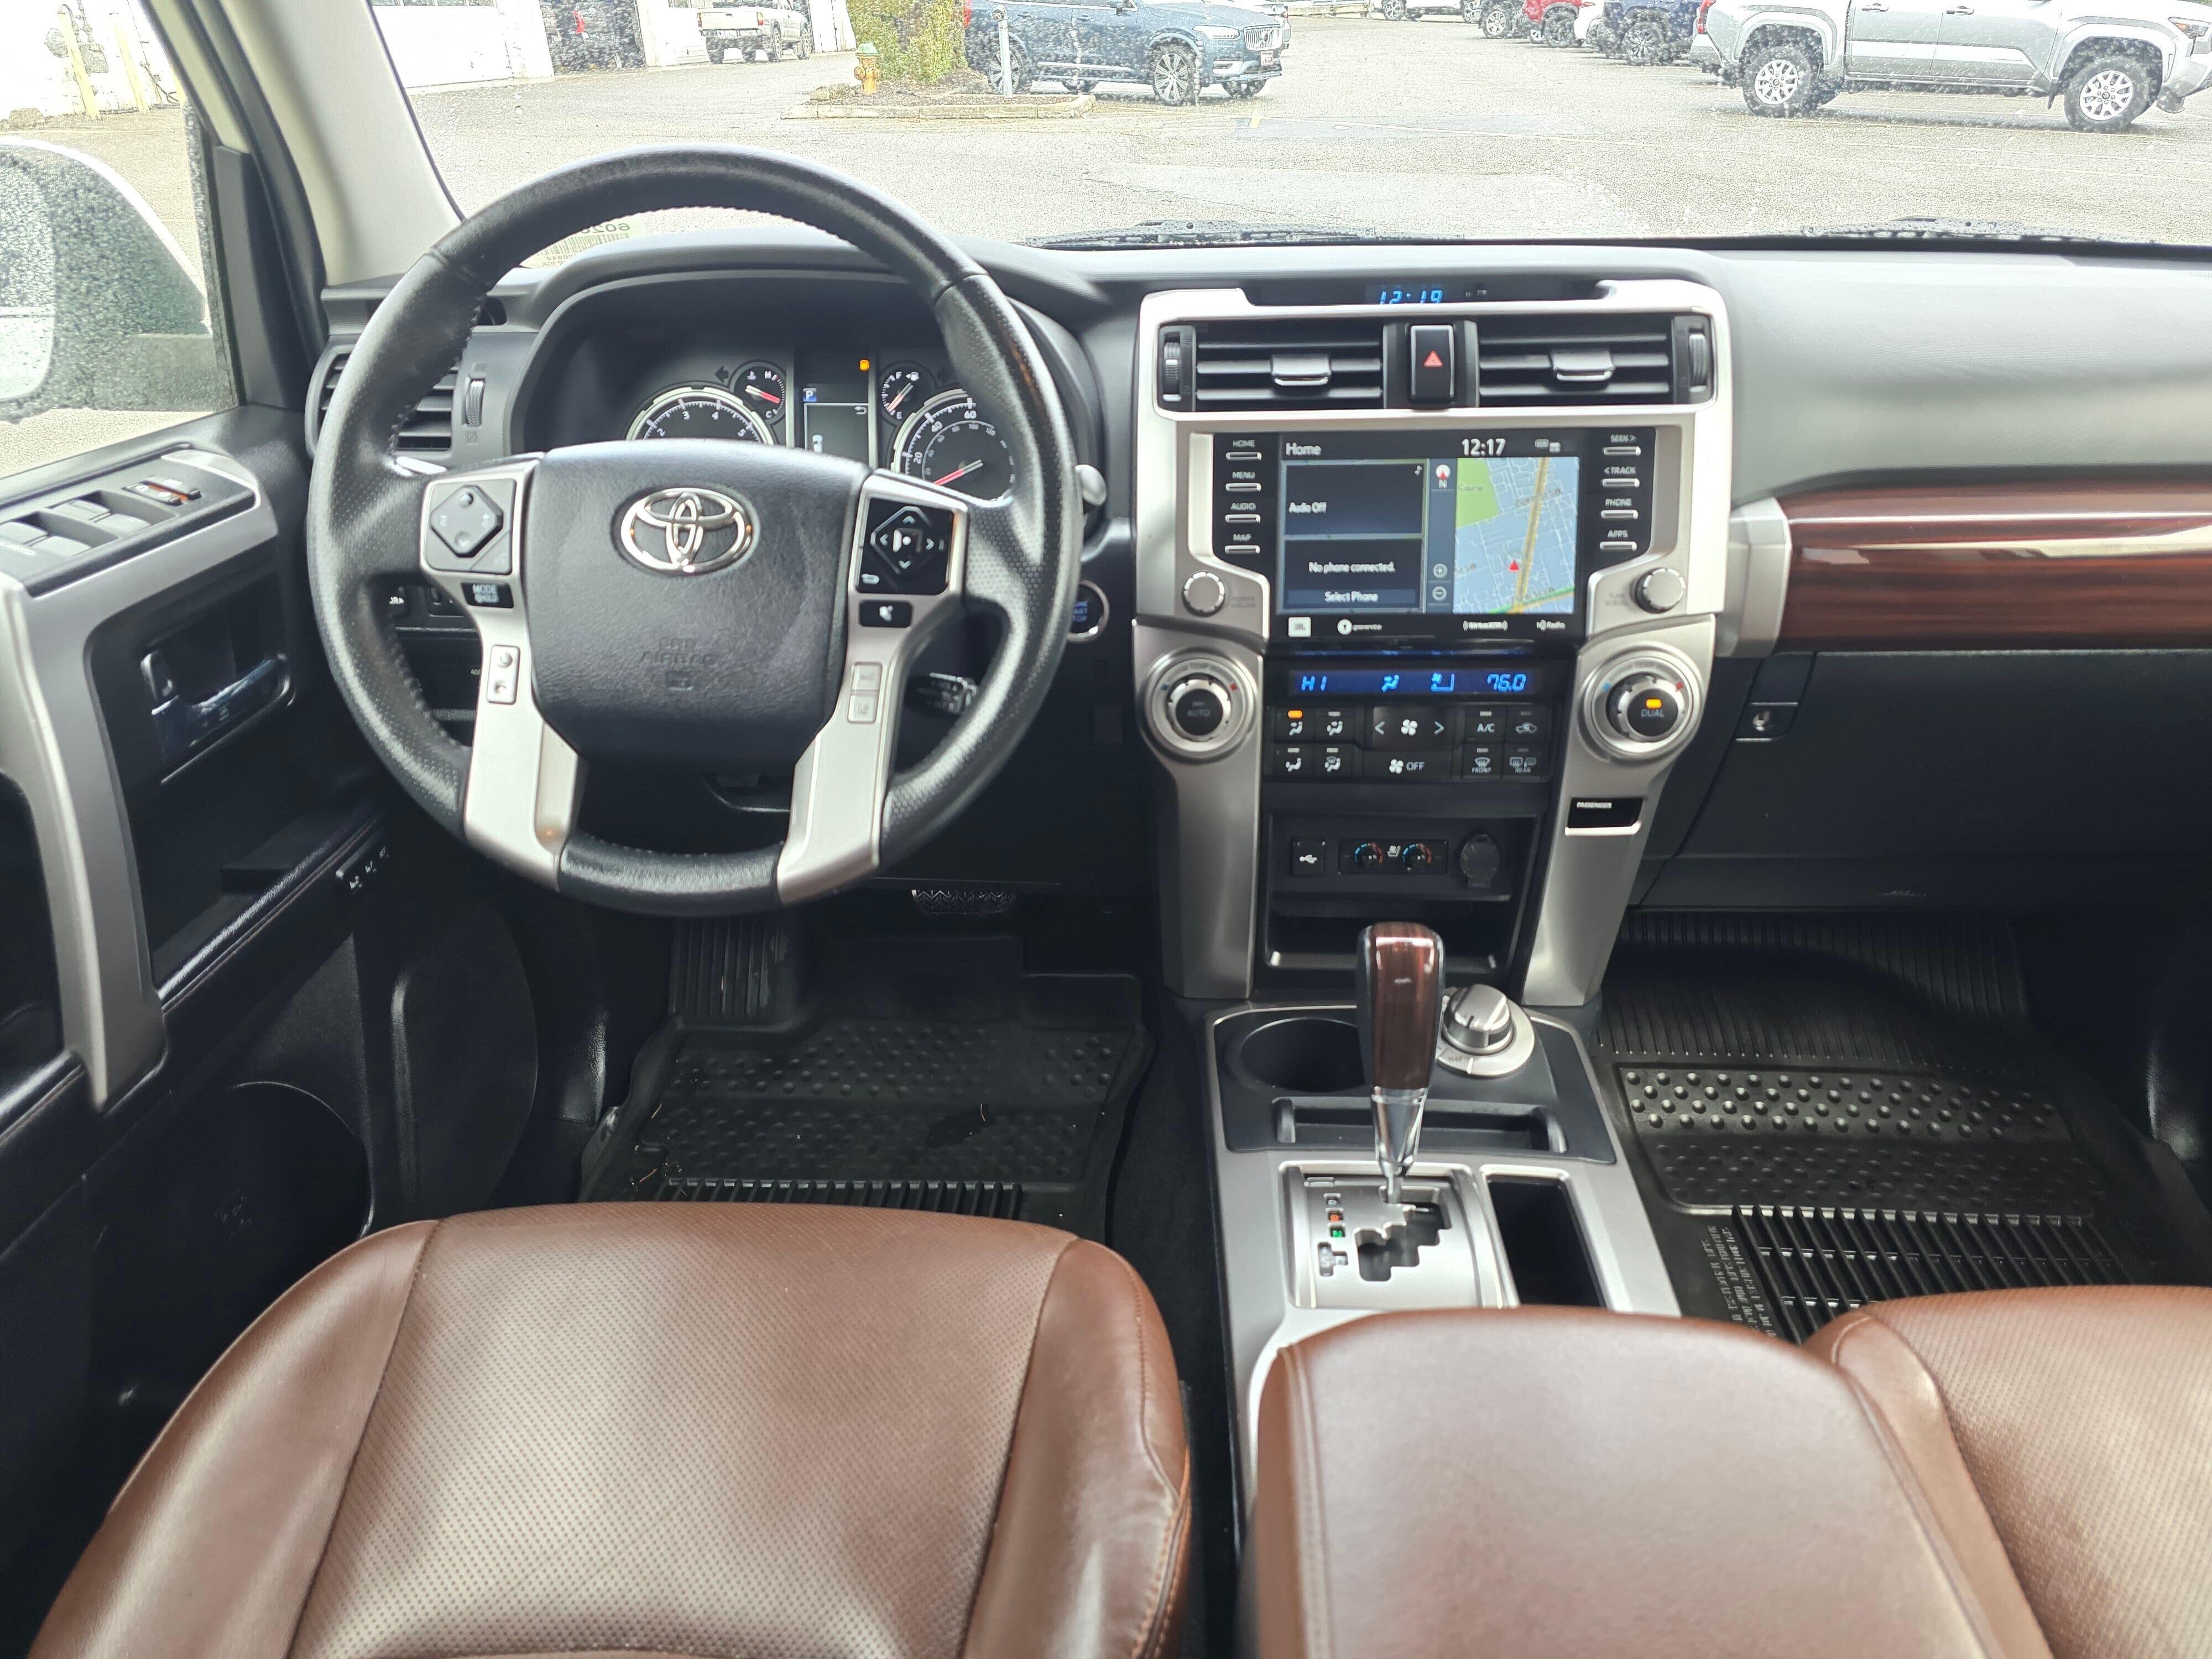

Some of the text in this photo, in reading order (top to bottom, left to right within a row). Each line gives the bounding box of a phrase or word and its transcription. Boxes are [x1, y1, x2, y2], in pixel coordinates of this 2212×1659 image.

[896, 371, 902, 379] F
[682, 411, 690, 420] 3
[711, 411, 719, 420] 4
[964, 410, 977, 419] 60
[931, 421, 943, 432] 40
[738, 428, 746, 437] 5
[1232, 440, 1256, 448] HOME
[1462, 438, 1506, 456] 12:17
[1286, 442, 1322, 456] Home
[914, 451, 923, 465] 20
[1438, 479, 1447, 488] N
[1230, 502, 1256, 511] AUDIO
[1605, 498, 1632, 507] PHONE
[1312, 502, 1327, 513] Off
[1233, 534, 1252, 542] MAP
[1608, 529, 1629, 538] APPS
[1309, 562, 1323, 573] No
[1323, 562, 1350, 574] phone
[472, 583, 496, 593] MODE
[1351, 591, 1379, 602] Phone
[1301, 676, 1327, 691] HI
[1487, 674, 1526, 692] 76.0
[1187, 708, 1211, 717] AUTO
[1641, 709, 1665, 717] DUAL
[1477, 723, 1495, 733] A/C
[1406, 761, 1425, 771] OFF
